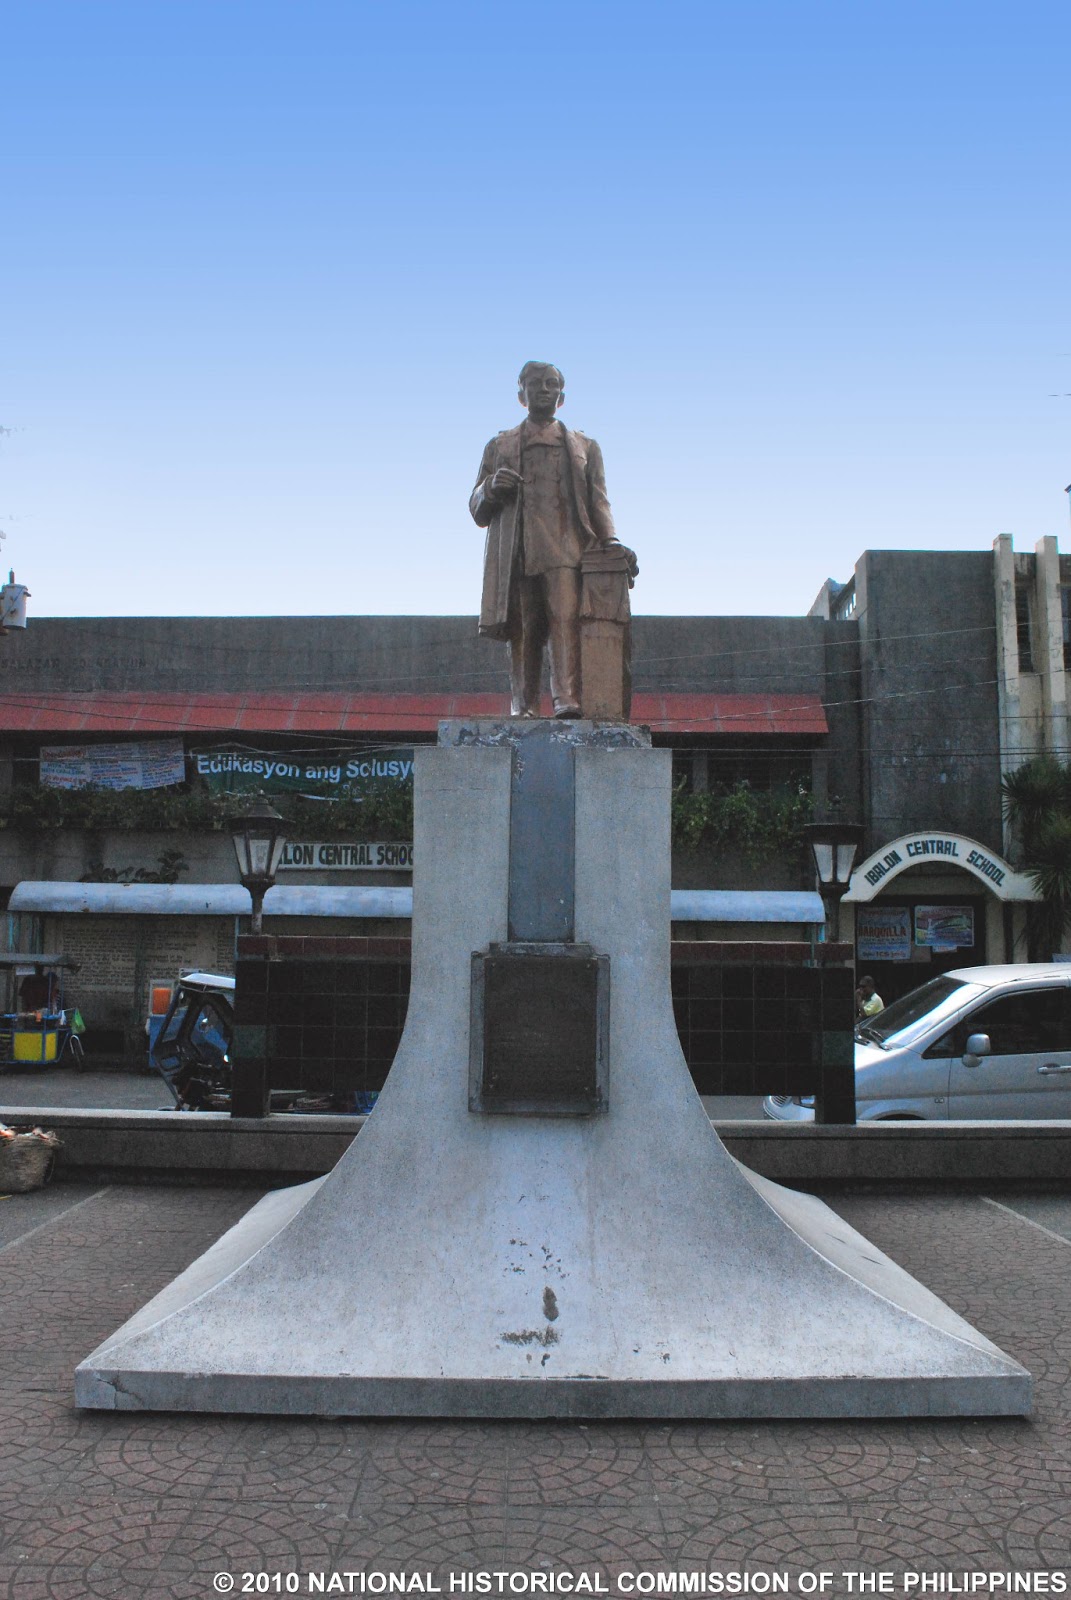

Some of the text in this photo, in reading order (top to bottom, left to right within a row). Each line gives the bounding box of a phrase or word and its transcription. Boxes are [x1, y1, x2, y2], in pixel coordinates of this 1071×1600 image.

[197, 755, 300, 779] Edukasyon
[305, 764, 341, 783] ang
[318, 845, 374, 865] CENTRAL
[377, 845, 414, 866] SCHOO
[864, 839, 1006, 887] IBALON CENTRAL SCHOOL
